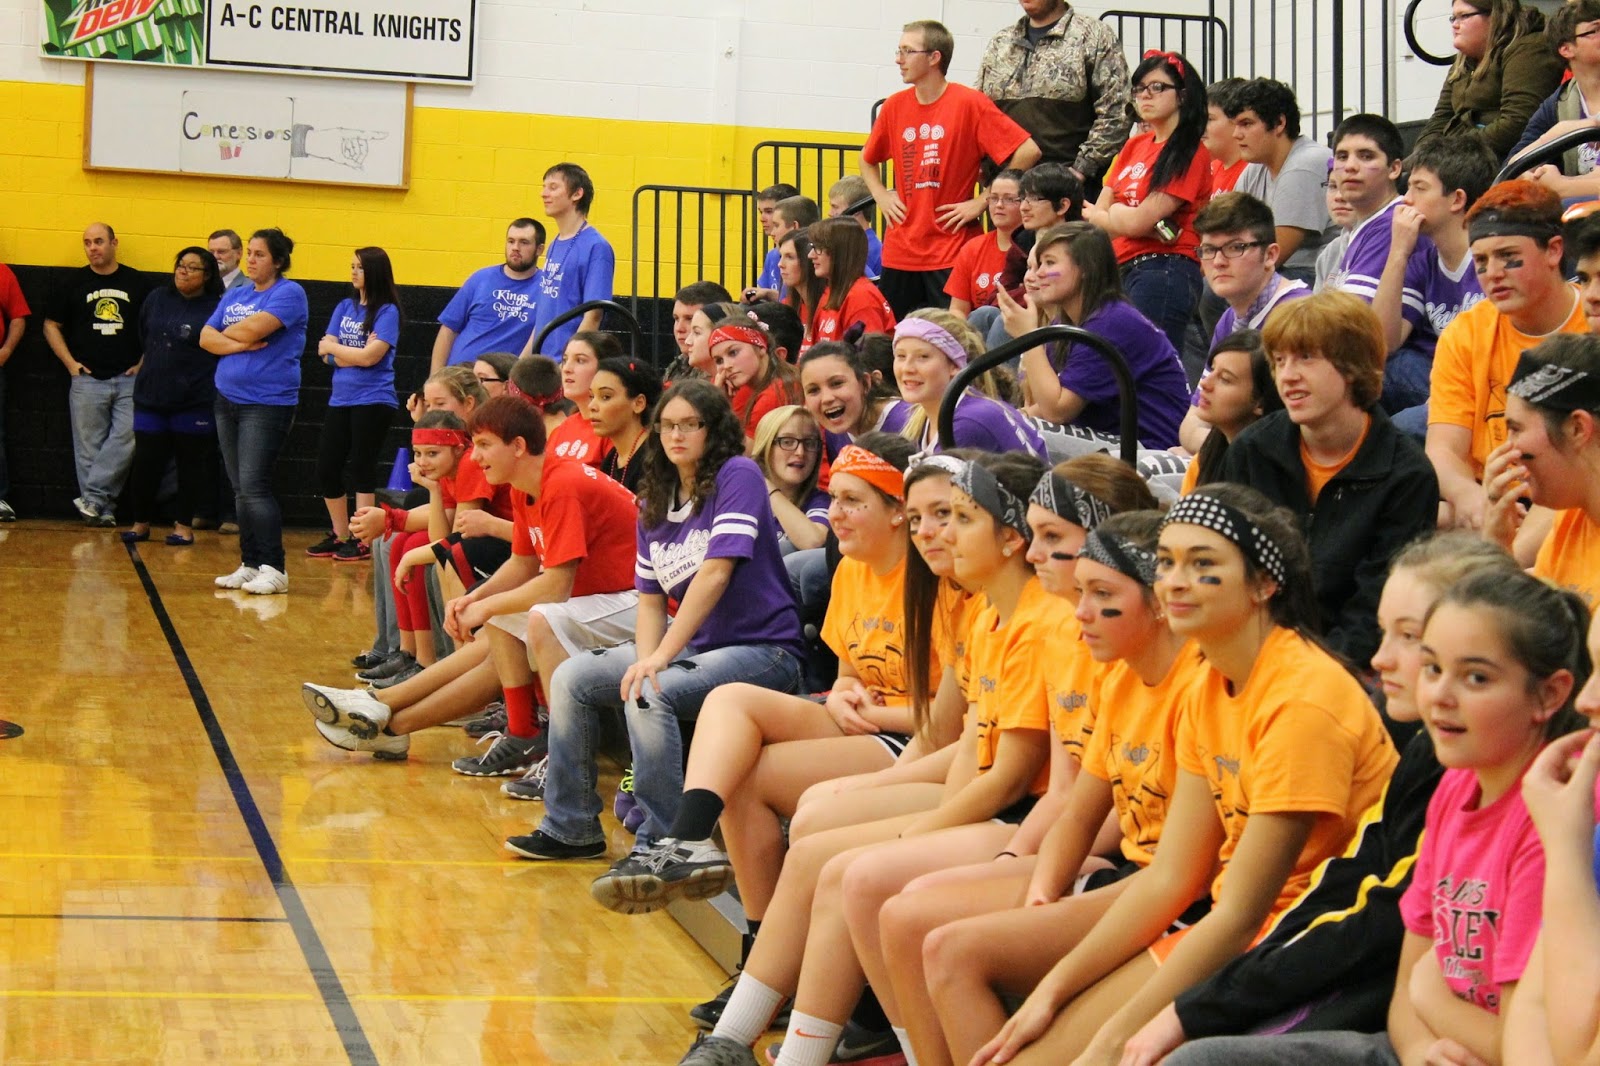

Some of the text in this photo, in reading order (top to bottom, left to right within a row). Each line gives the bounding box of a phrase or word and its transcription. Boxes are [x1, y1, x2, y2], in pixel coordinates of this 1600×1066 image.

[220, 3, 462, 42] A-C CENTRAL KNIGHTS
[182, 111, 292, 140] Concessions
[492, 289, 529, 305] Kings
[226, 302, 256, 316] Kings
[492, 302, 522, 312] Queens
[348, 339, 366, 347] 2015
[649, 528, 711, 570] Knights
[669, 560, 696, 580] CENTRAL
